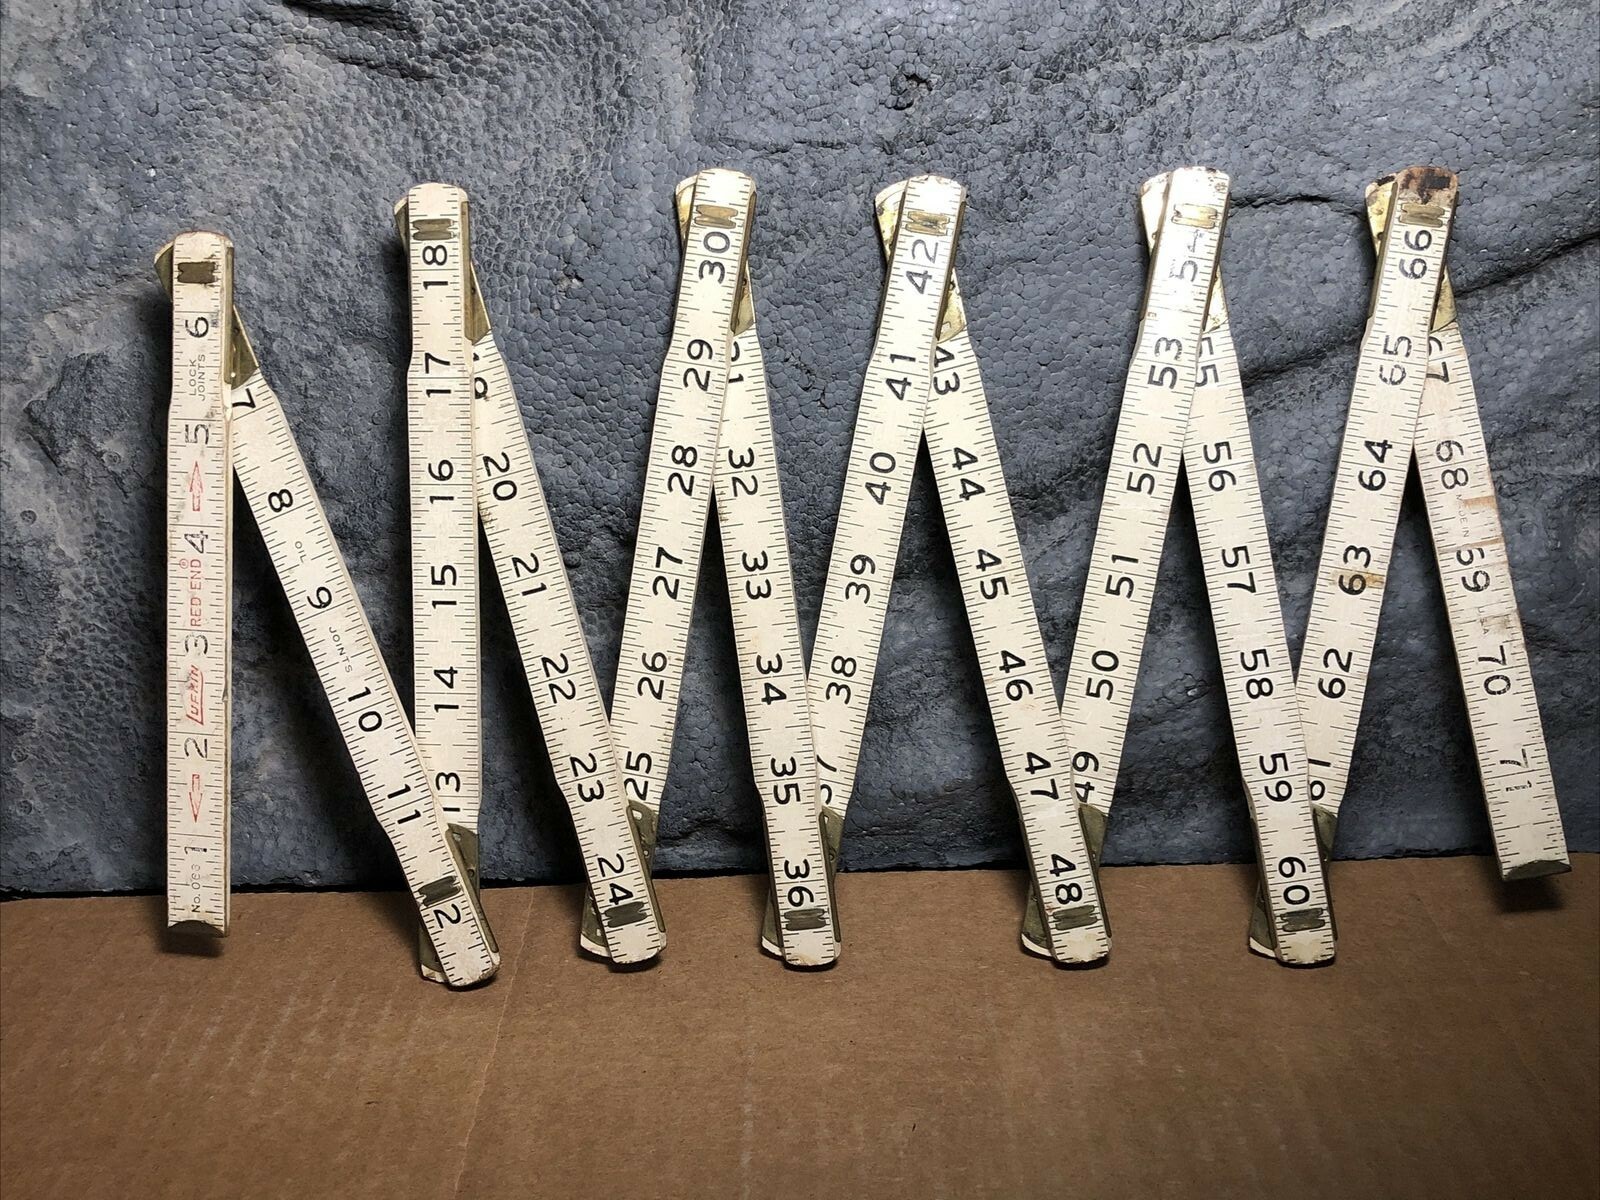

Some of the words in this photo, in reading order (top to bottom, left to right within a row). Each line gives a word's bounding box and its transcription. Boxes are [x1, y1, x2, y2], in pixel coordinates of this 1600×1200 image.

[422, 244, 448, 290] 18
[699, 231, 730, 284] 30
[906, 239, 938, 294] 42
[1399, 229, 1432, 280] 66
[185, 316, 209, 339] 6
[188, 358, 198, 397] LOCK
[197, 353, 207, 401] JOINTS
[425, 352, 451, 398] 17
[683, 339, 713, 392] 29
[886, 353, 916, 400] 41
[1148, 337, 1183, 390] 53
[1379, 335, 1413, 386] 65
[231, 387, 256, 410] 7
[185, 423, 209, 446] 5
[428, 459, 454, 504] 16
[482, 452, 517, 500] 20
[668, 445, 697, 496] 28
[728, 447, 758, 497] 32
[865, 452, 896, 505] 40
[952, 447, 986, 501] 44
[1126, 443, 1162, 495] 52
[1203, 441, 1236, 492] 56
[1358, 439, 1392, 492] 64
[1435, 439, 1469, 490] 68
[267, 488, 294, 513] 8
[1455, 494, 1468, 525] MDE
[184, 531, 209, 554] 4
[295, 540, 307, 563] OIL
[431, 564, 457, 609] 15
[511, 552, 547, 596] 21
[653, 546, 683, 600] 27
[742, 550, 772, 600] 33
[845, 554, 876, 604] 39
[976, 549, 1009, 600] 45
[1105, 554, 1139, 599] 51
[1221, 545, 1256, 594] 57
[1338, 545, 1371, 596] 63
[1456, 547, 1491, 593] 69
[190, 597, 202, 627] RED
[307, 586, 332, 609] 9
[184, 633, 208, 655] 3
[328, 626, 353, 673] JOINTS
[434, 666, 459, 712] 14
[541, 653, 576, 704] 22
[637, 652, 667, 700] 26
[756, 653, 787, 705] 34
[826, 655, 857, 705] 38
[1000, 650, 1034, 701] 46
[1085, 650, 1119, 701] 50
[1240, 649, 1274, 699] 58
[1318, 648, 1353, 700] 62
[1478, 645, 1512, 695] 70
[348, 686, 382, 732] 10
[184, 738, 207, 758] 2
[1500, 748, 1532, 791] 71
[570, 753, 605, 803] 23
[624, 751, 652, 800] 25
[770, 756, 801, 806] 35
[1024, 751, 1059, 801] 47
[1259, 752, 1293, 802] 59
[387, 783, 421, 824] 11
[184, 846, 207, 855] 1
[597, 853, 634, 905] 24
[784, 859, 814, 908] 36
[1050, 853, 1083, 906] 48
[1278, 856, 1310, 905] 60
